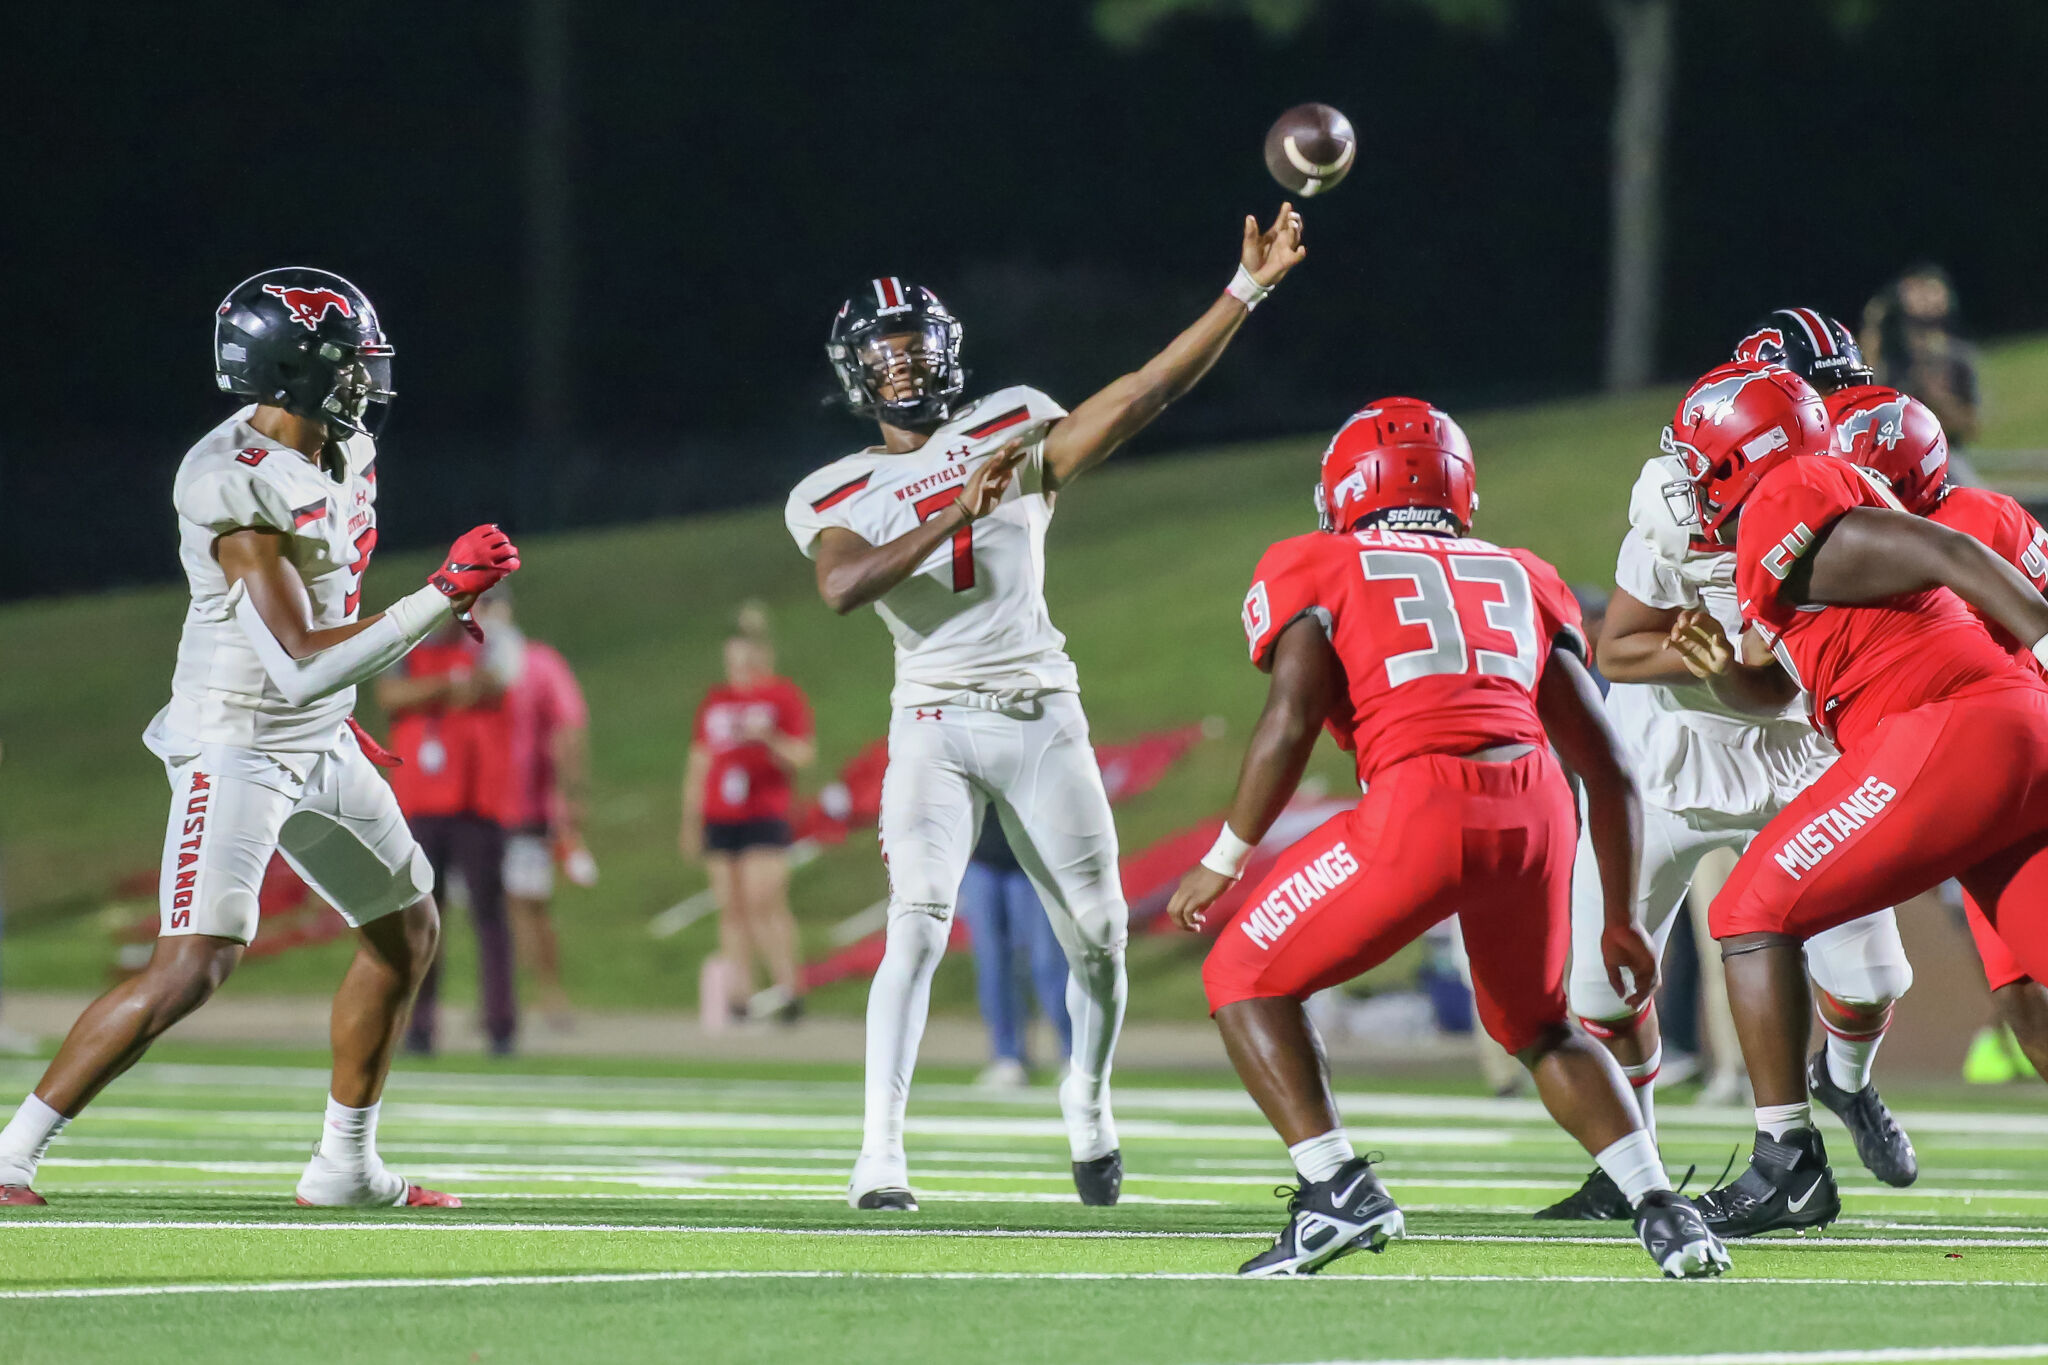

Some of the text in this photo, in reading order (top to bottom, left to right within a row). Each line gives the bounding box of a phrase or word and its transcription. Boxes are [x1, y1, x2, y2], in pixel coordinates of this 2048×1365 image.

[894, 463, 968, 501] WESTFIELD
[913, 483, 976, 594] 7
[1359, 550, 1538, 692] 33
[170, 771, 211, 929] MUSTANGS
[1774, 775, 1897, 882] MUSTANGS
[1241, 841, 1360, 950] MUSTANGS
